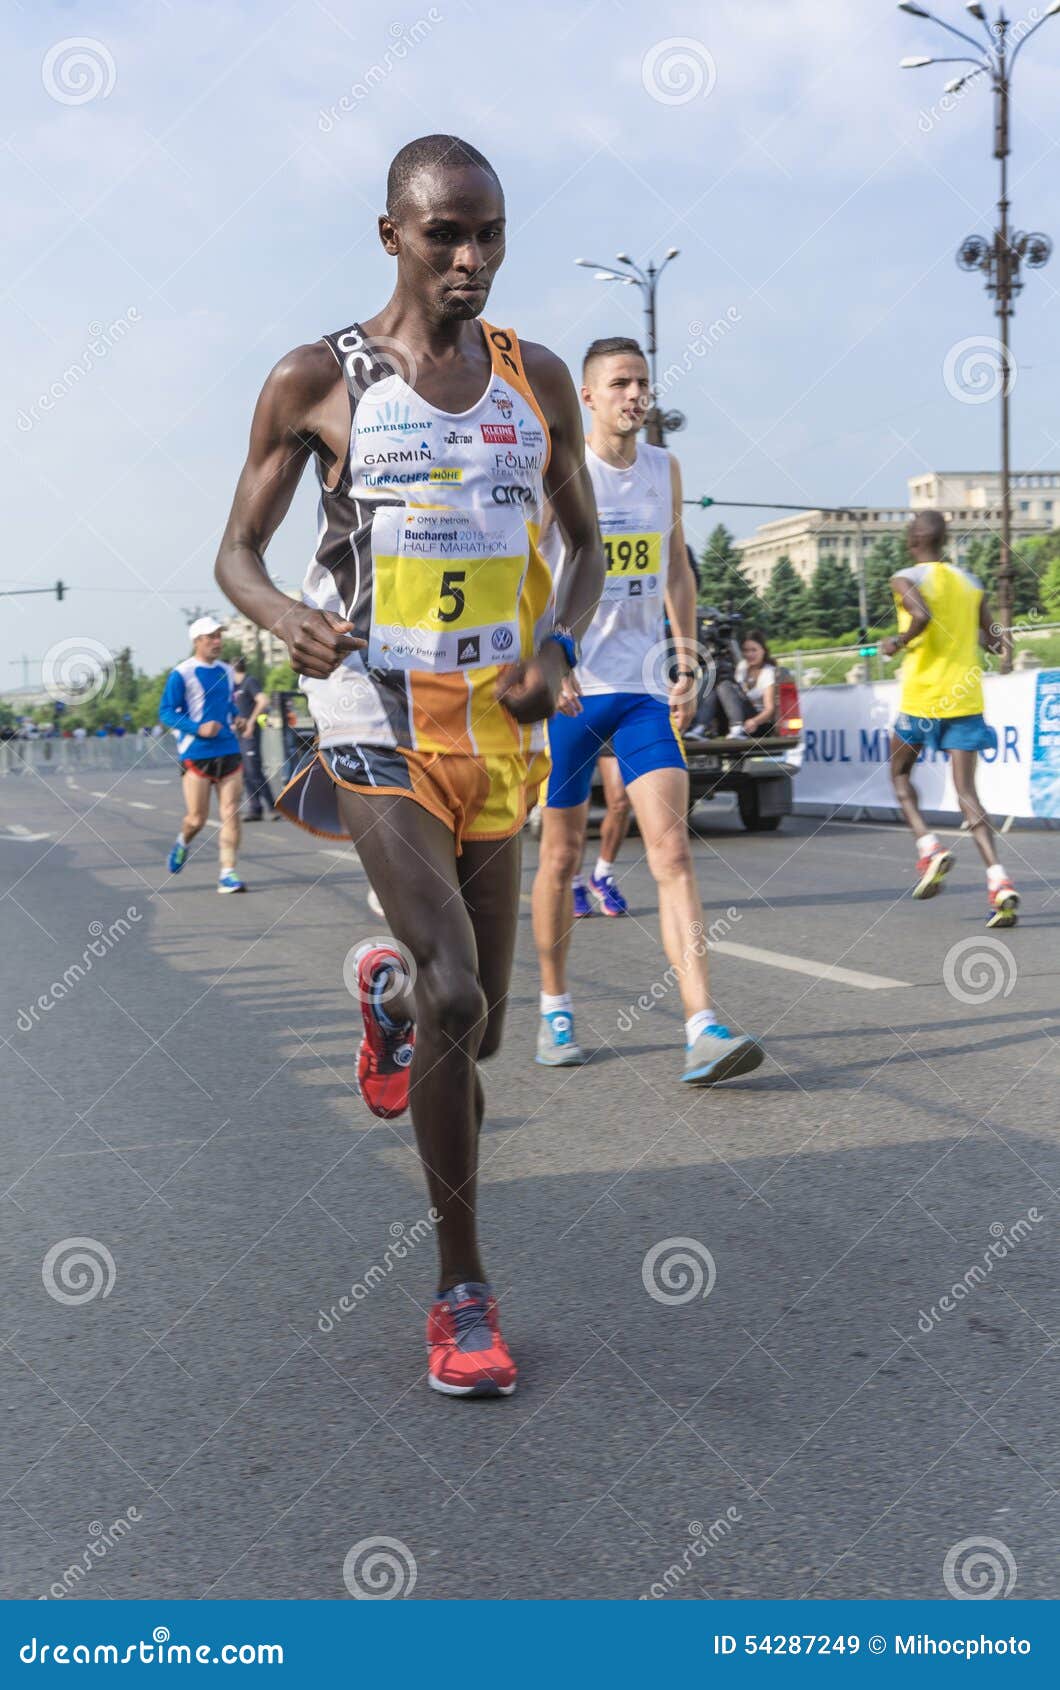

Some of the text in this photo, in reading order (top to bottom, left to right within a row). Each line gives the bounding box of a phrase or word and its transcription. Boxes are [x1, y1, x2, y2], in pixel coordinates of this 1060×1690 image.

[358, 422, 433, 434] LOIPERSDORF
[484, 425, 513, 434] KLEINE
[361, 472, 429, 486] TURRACHER
[417, 517, 438, 525] OMV
[405, 530, 457, 541] Bucharest
[404, 541, 507, 553] HALF MARATHON
[437, 571, 466, 622] 5
